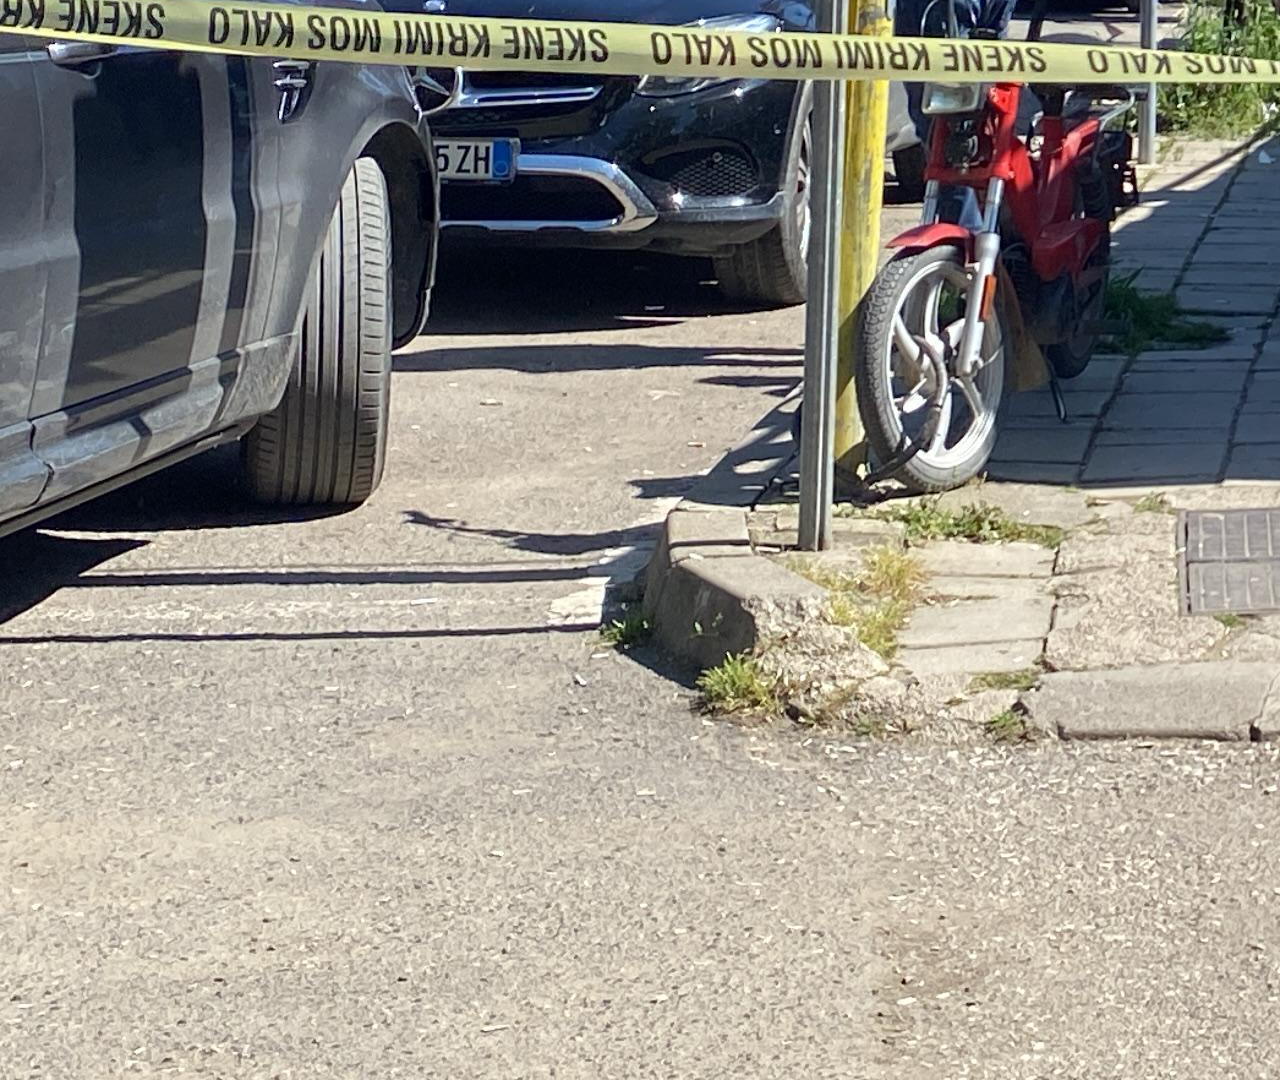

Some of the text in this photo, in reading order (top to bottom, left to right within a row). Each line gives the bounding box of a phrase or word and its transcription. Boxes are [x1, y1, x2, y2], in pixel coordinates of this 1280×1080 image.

[208, 6, 609, 63] SKENE KRIMI MOS KALO
[651, 31, 1048, 73] SKENE KRIMI MOS KALO
[1087, 49, 1172, 75] KALO
[454, 145, 491, 174] ZH
